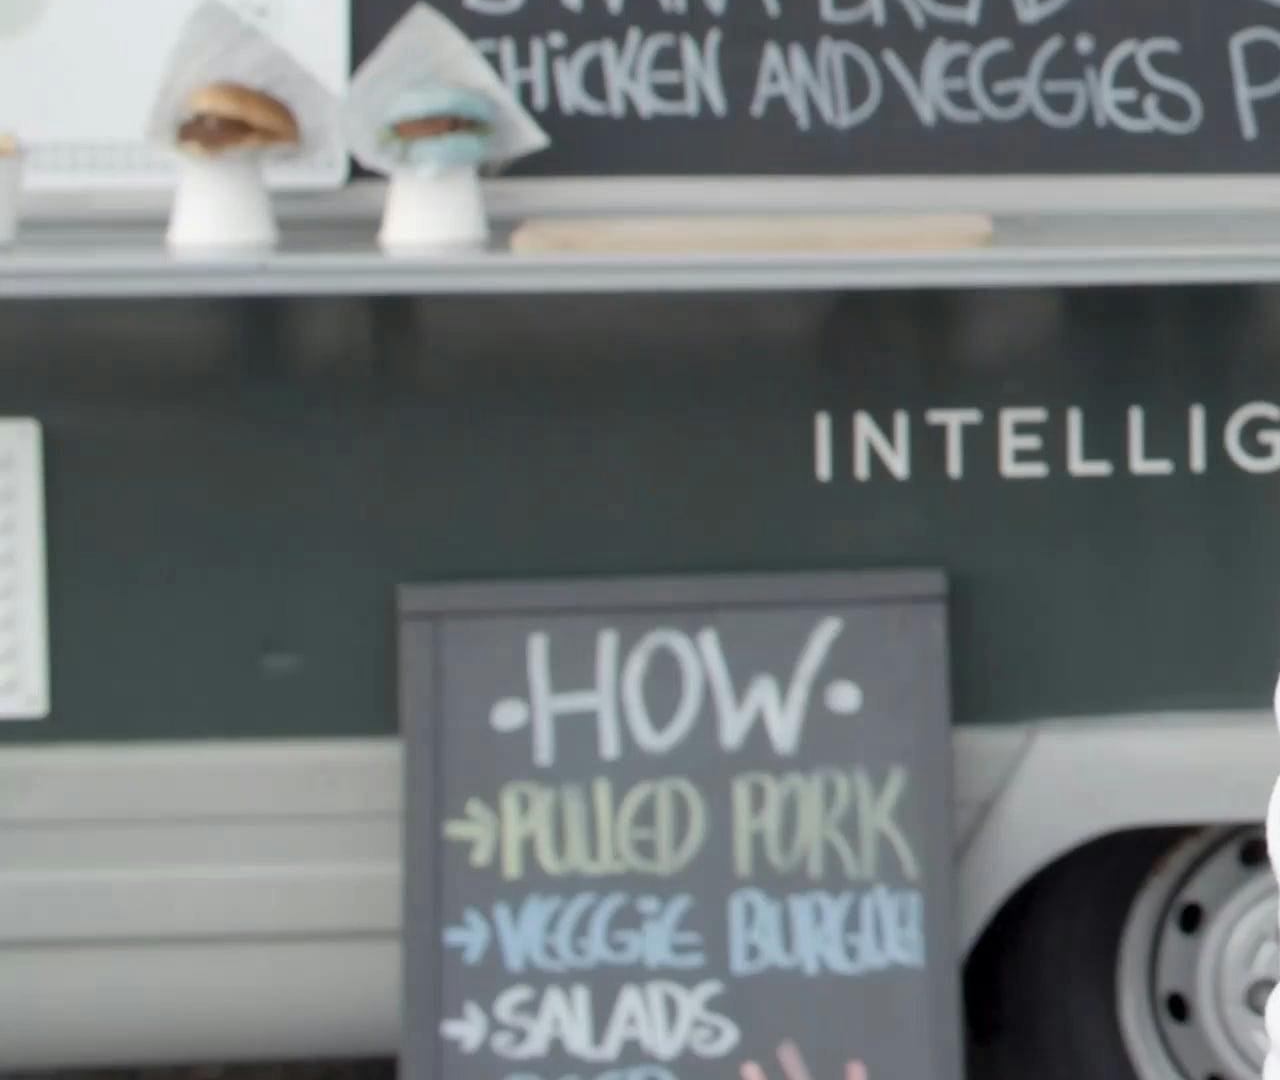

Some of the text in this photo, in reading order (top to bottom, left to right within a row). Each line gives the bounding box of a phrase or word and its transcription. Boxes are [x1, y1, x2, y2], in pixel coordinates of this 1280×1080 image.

[749, 34, 882, 131] AND
[525, 616, 845, 769] HOW
[500, 765, 923, 882] PULLED PORK
[490, 978, 742, 1062] SALADS
